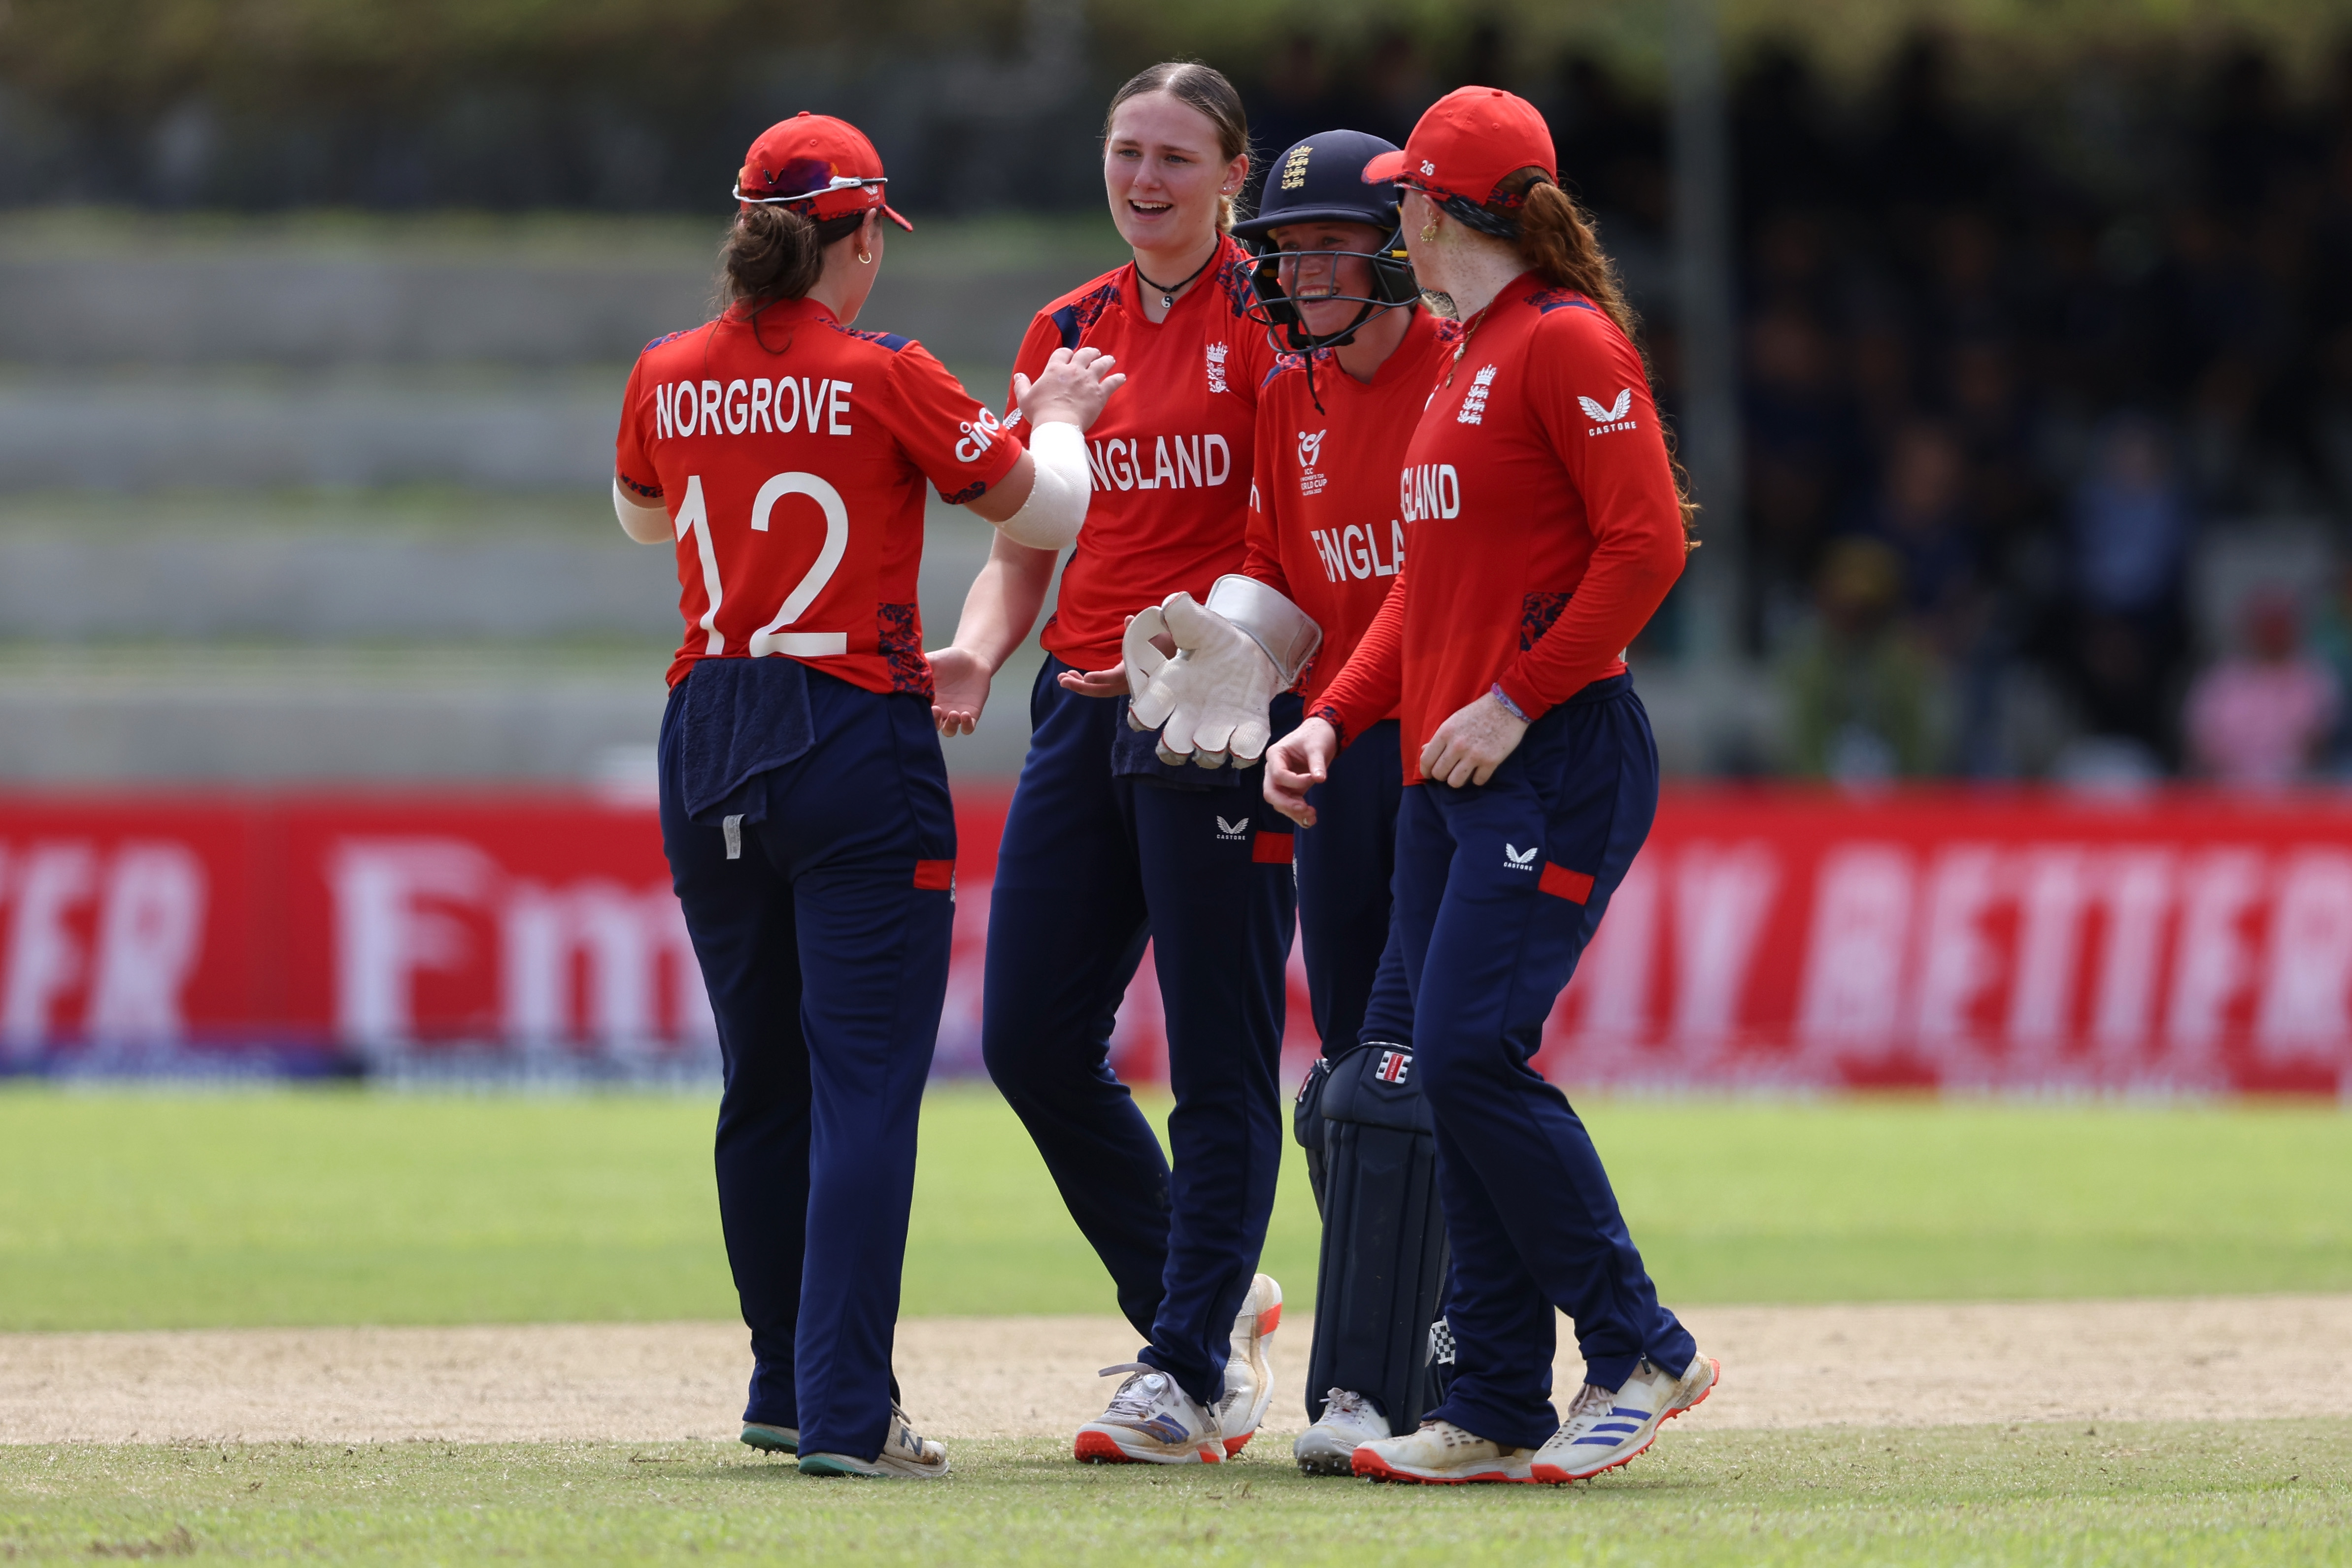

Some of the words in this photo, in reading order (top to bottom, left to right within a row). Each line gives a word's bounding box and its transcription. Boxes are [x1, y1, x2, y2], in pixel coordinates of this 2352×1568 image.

[1419, 160, 1435, 176] 26
[656, 376, 853, 440] NORGROVE
[955, 407, 1000, 463] cinc
[1588, 421, 1636, 437] CASTORE
[1084, 434, 1231, 492] NGLAND
[1314, 478, 1327, 488] CUP
[1400, 464, 1460, 524] GLAND
[674, 471, 849, 658] 12
[1310, 519, 1405, 583] ENGLA
[1503, 862, 1533, 871] CASTORE
